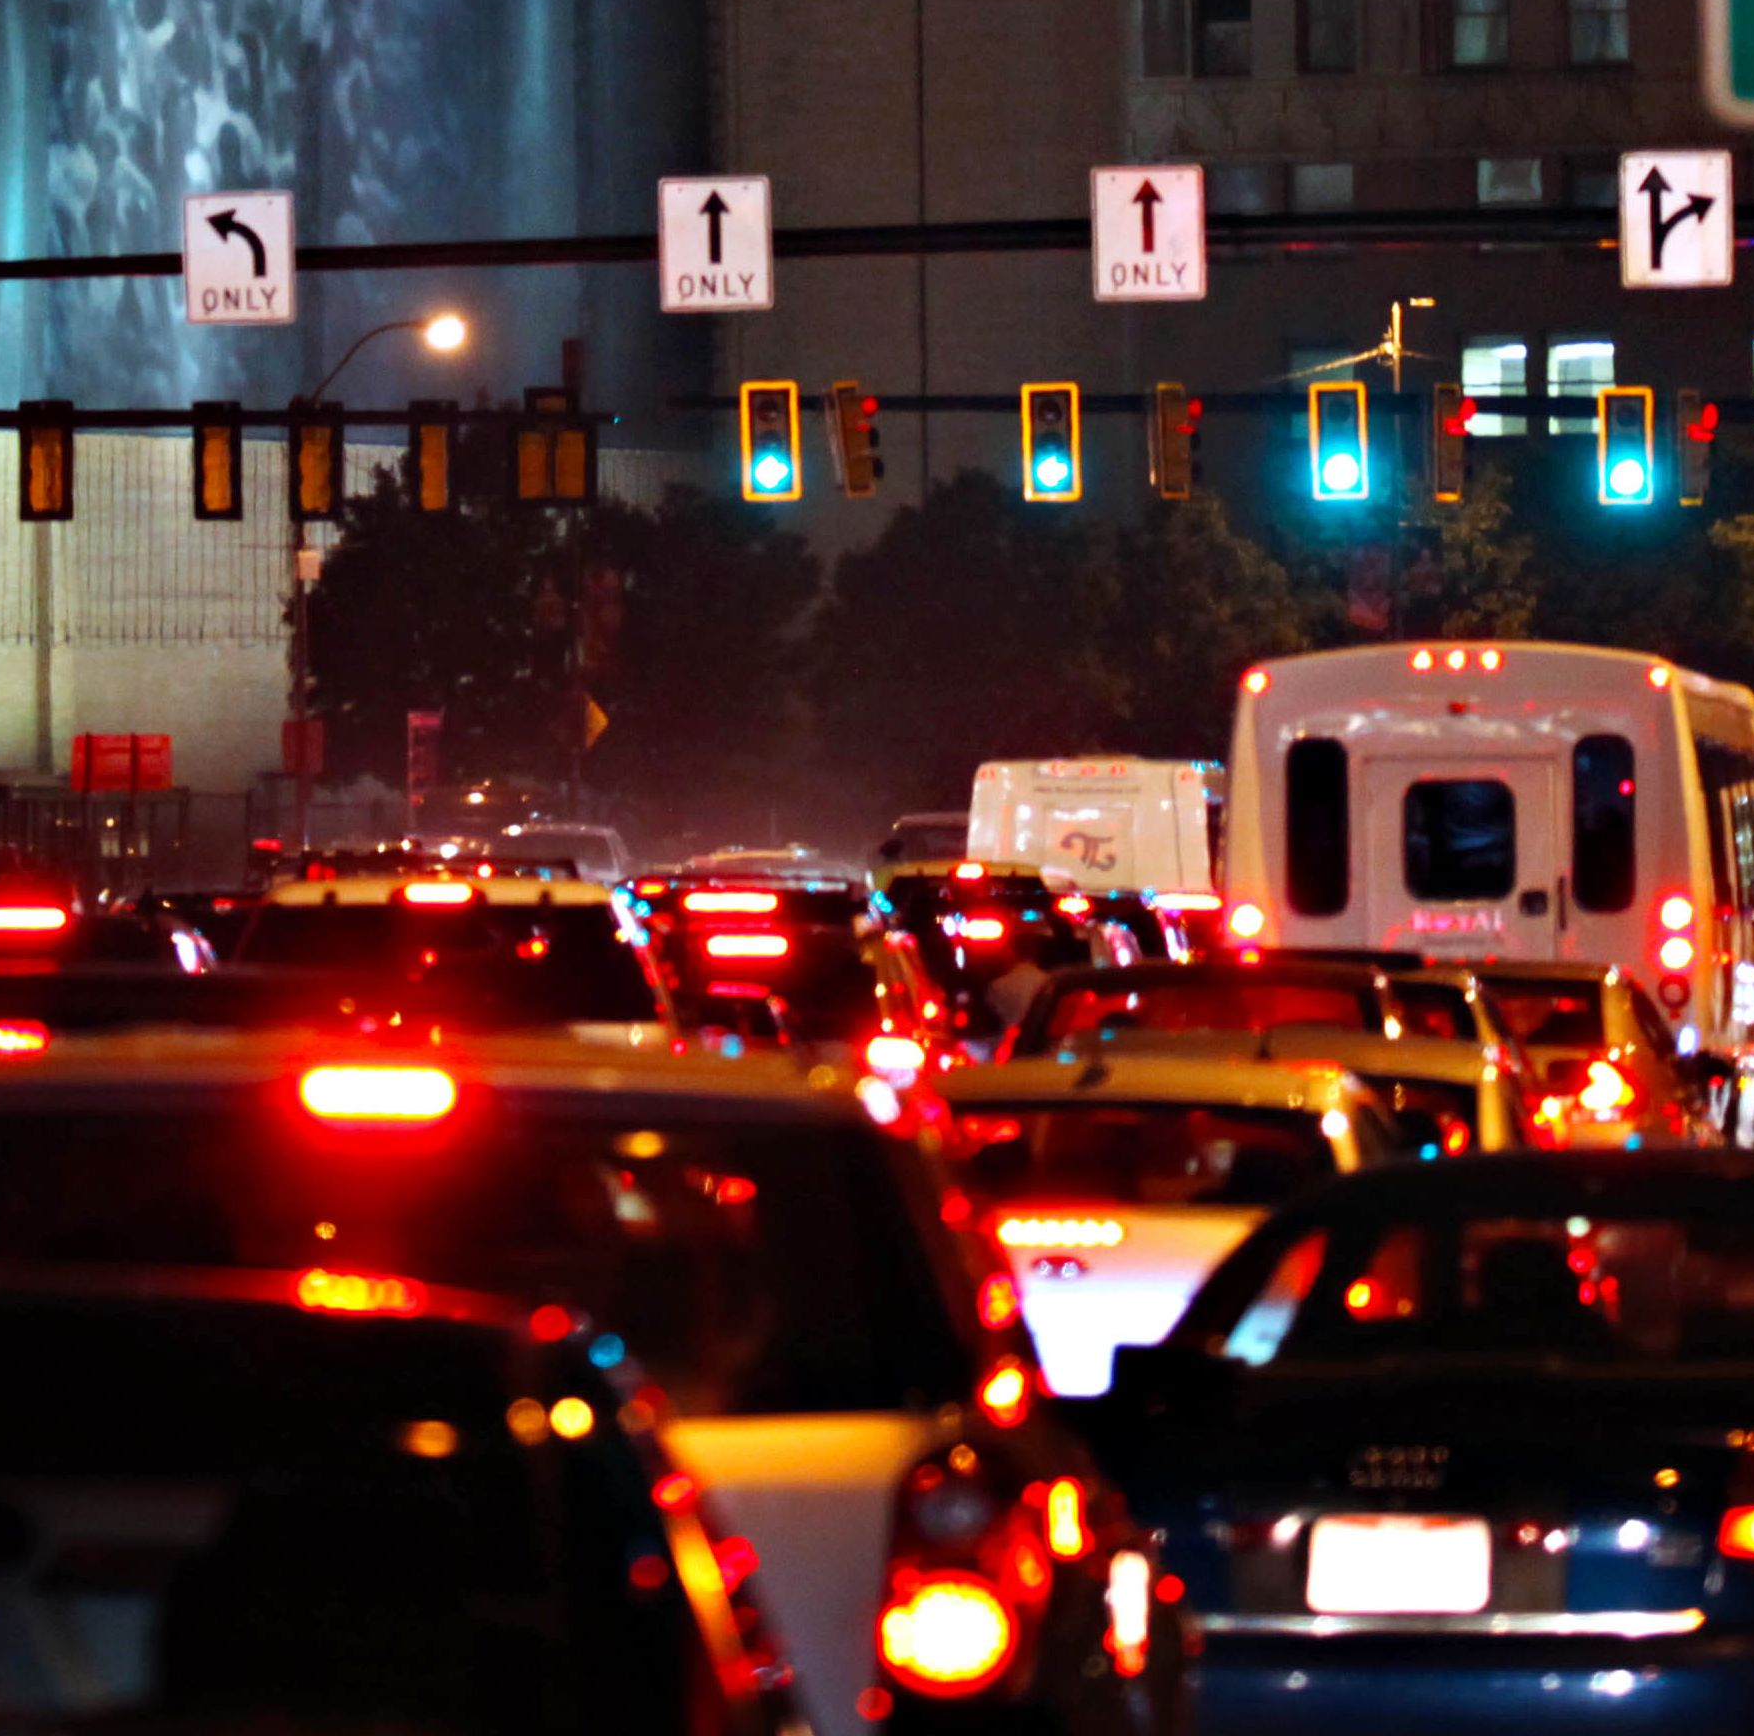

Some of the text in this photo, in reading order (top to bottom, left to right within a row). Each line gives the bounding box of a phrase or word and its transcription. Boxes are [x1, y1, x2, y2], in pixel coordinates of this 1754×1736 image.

[678, 273, 755, 298] ONLY
[1111, 261, 1187, 290] ONLY
[202, 286, 278, 312] ONLY
